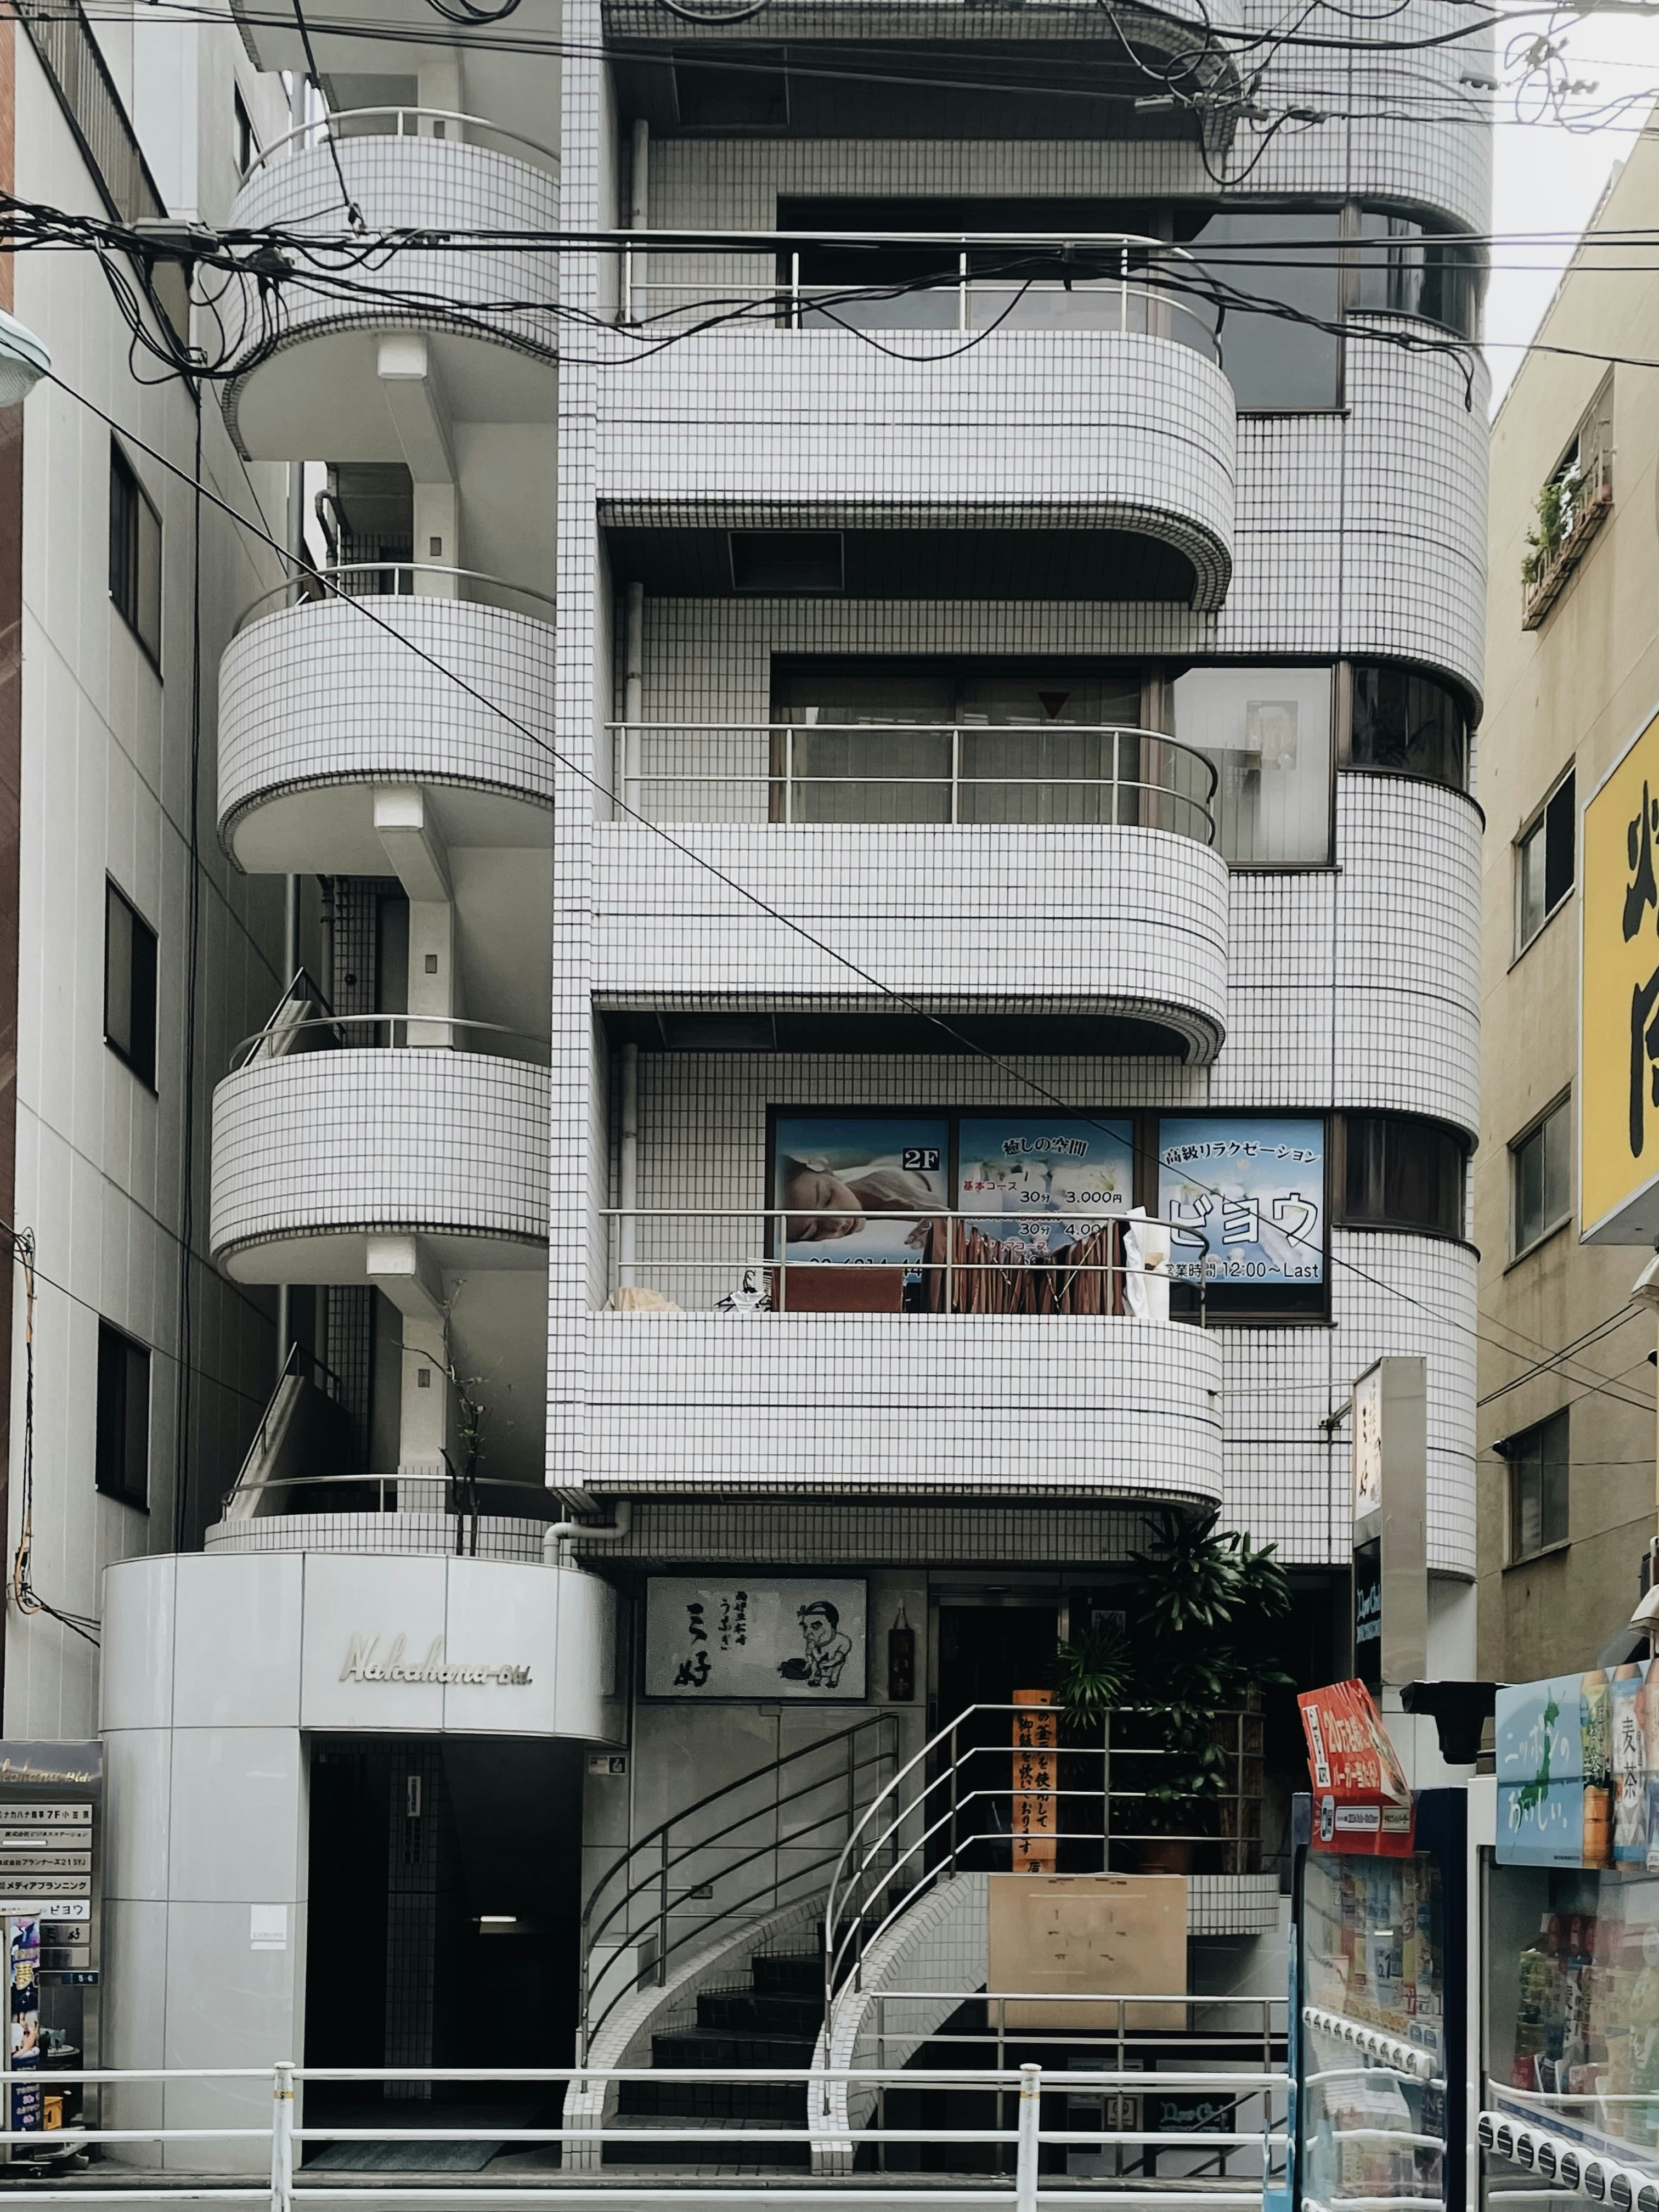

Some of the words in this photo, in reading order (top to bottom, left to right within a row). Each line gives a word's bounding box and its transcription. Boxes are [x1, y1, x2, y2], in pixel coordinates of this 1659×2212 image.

[1003, 1137, 1088, 1157] 癒しの空間
[1165, 1141, 1320, 1165] 高級リラクゼーション
[905, 1150, 939, 1169] 2F
[963, 1181, 1018, 1191] 基本コース
[1020, 1191, 1051, 1203] 30分
[1621, 1716, 1638, 1799] 麦茶
